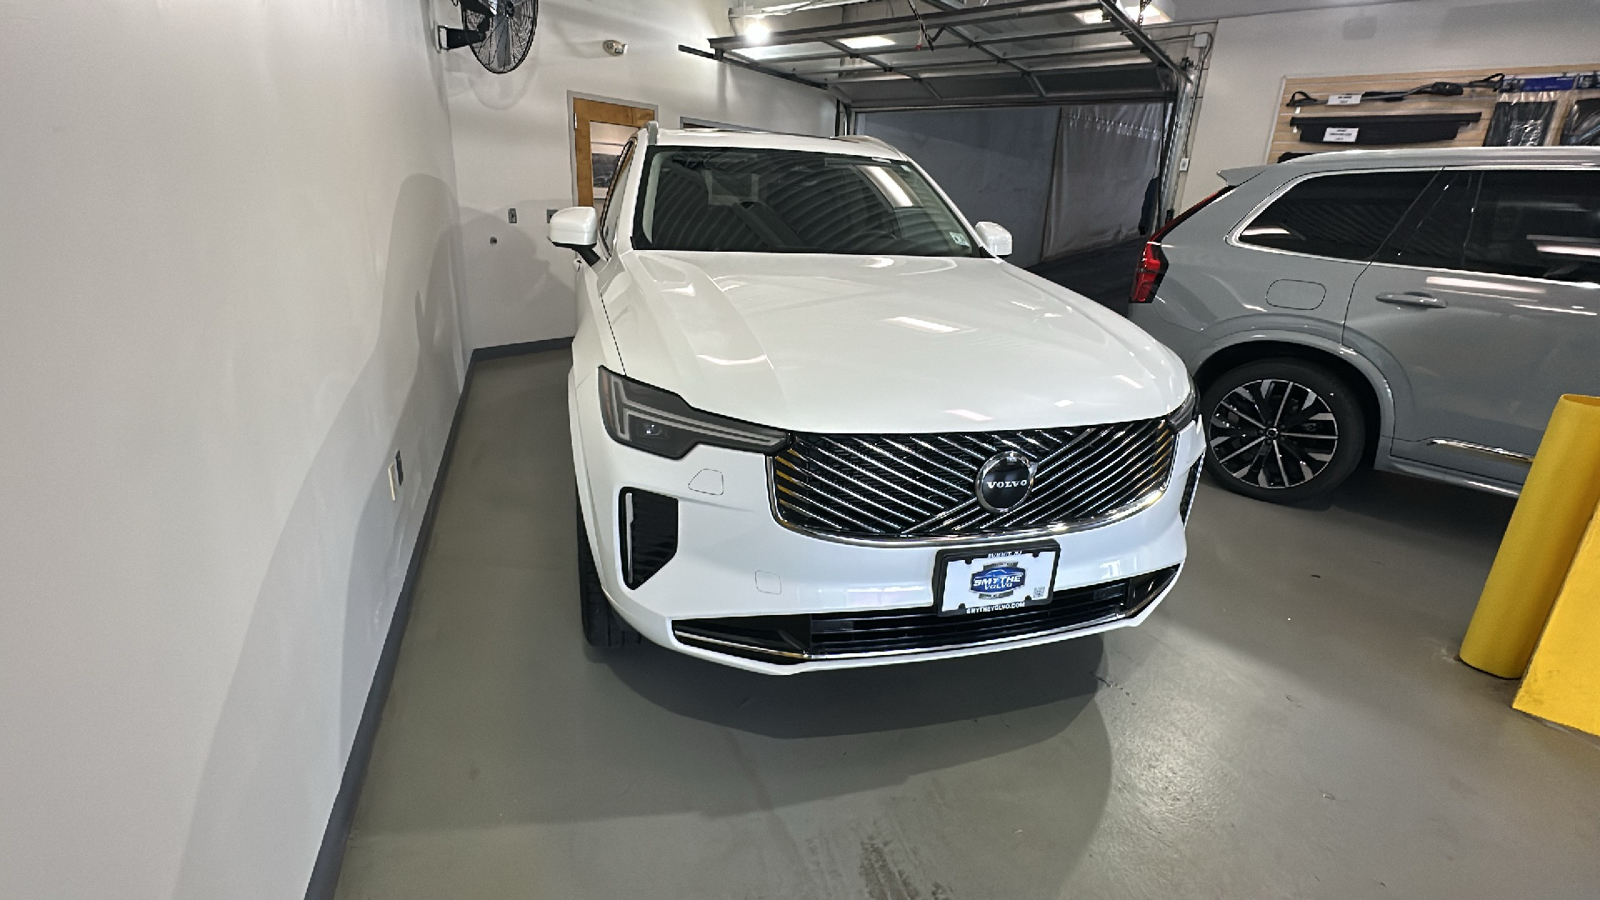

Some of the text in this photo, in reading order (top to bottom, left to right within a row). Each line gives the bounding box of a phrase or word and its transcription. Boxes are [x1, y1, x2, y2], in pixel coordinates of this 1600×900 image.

[986, 479, 1027, 489] VOLVO
[973, 574, 1022, 587] SMYTHE
[984, 581, 1013, 590] VOLVO
